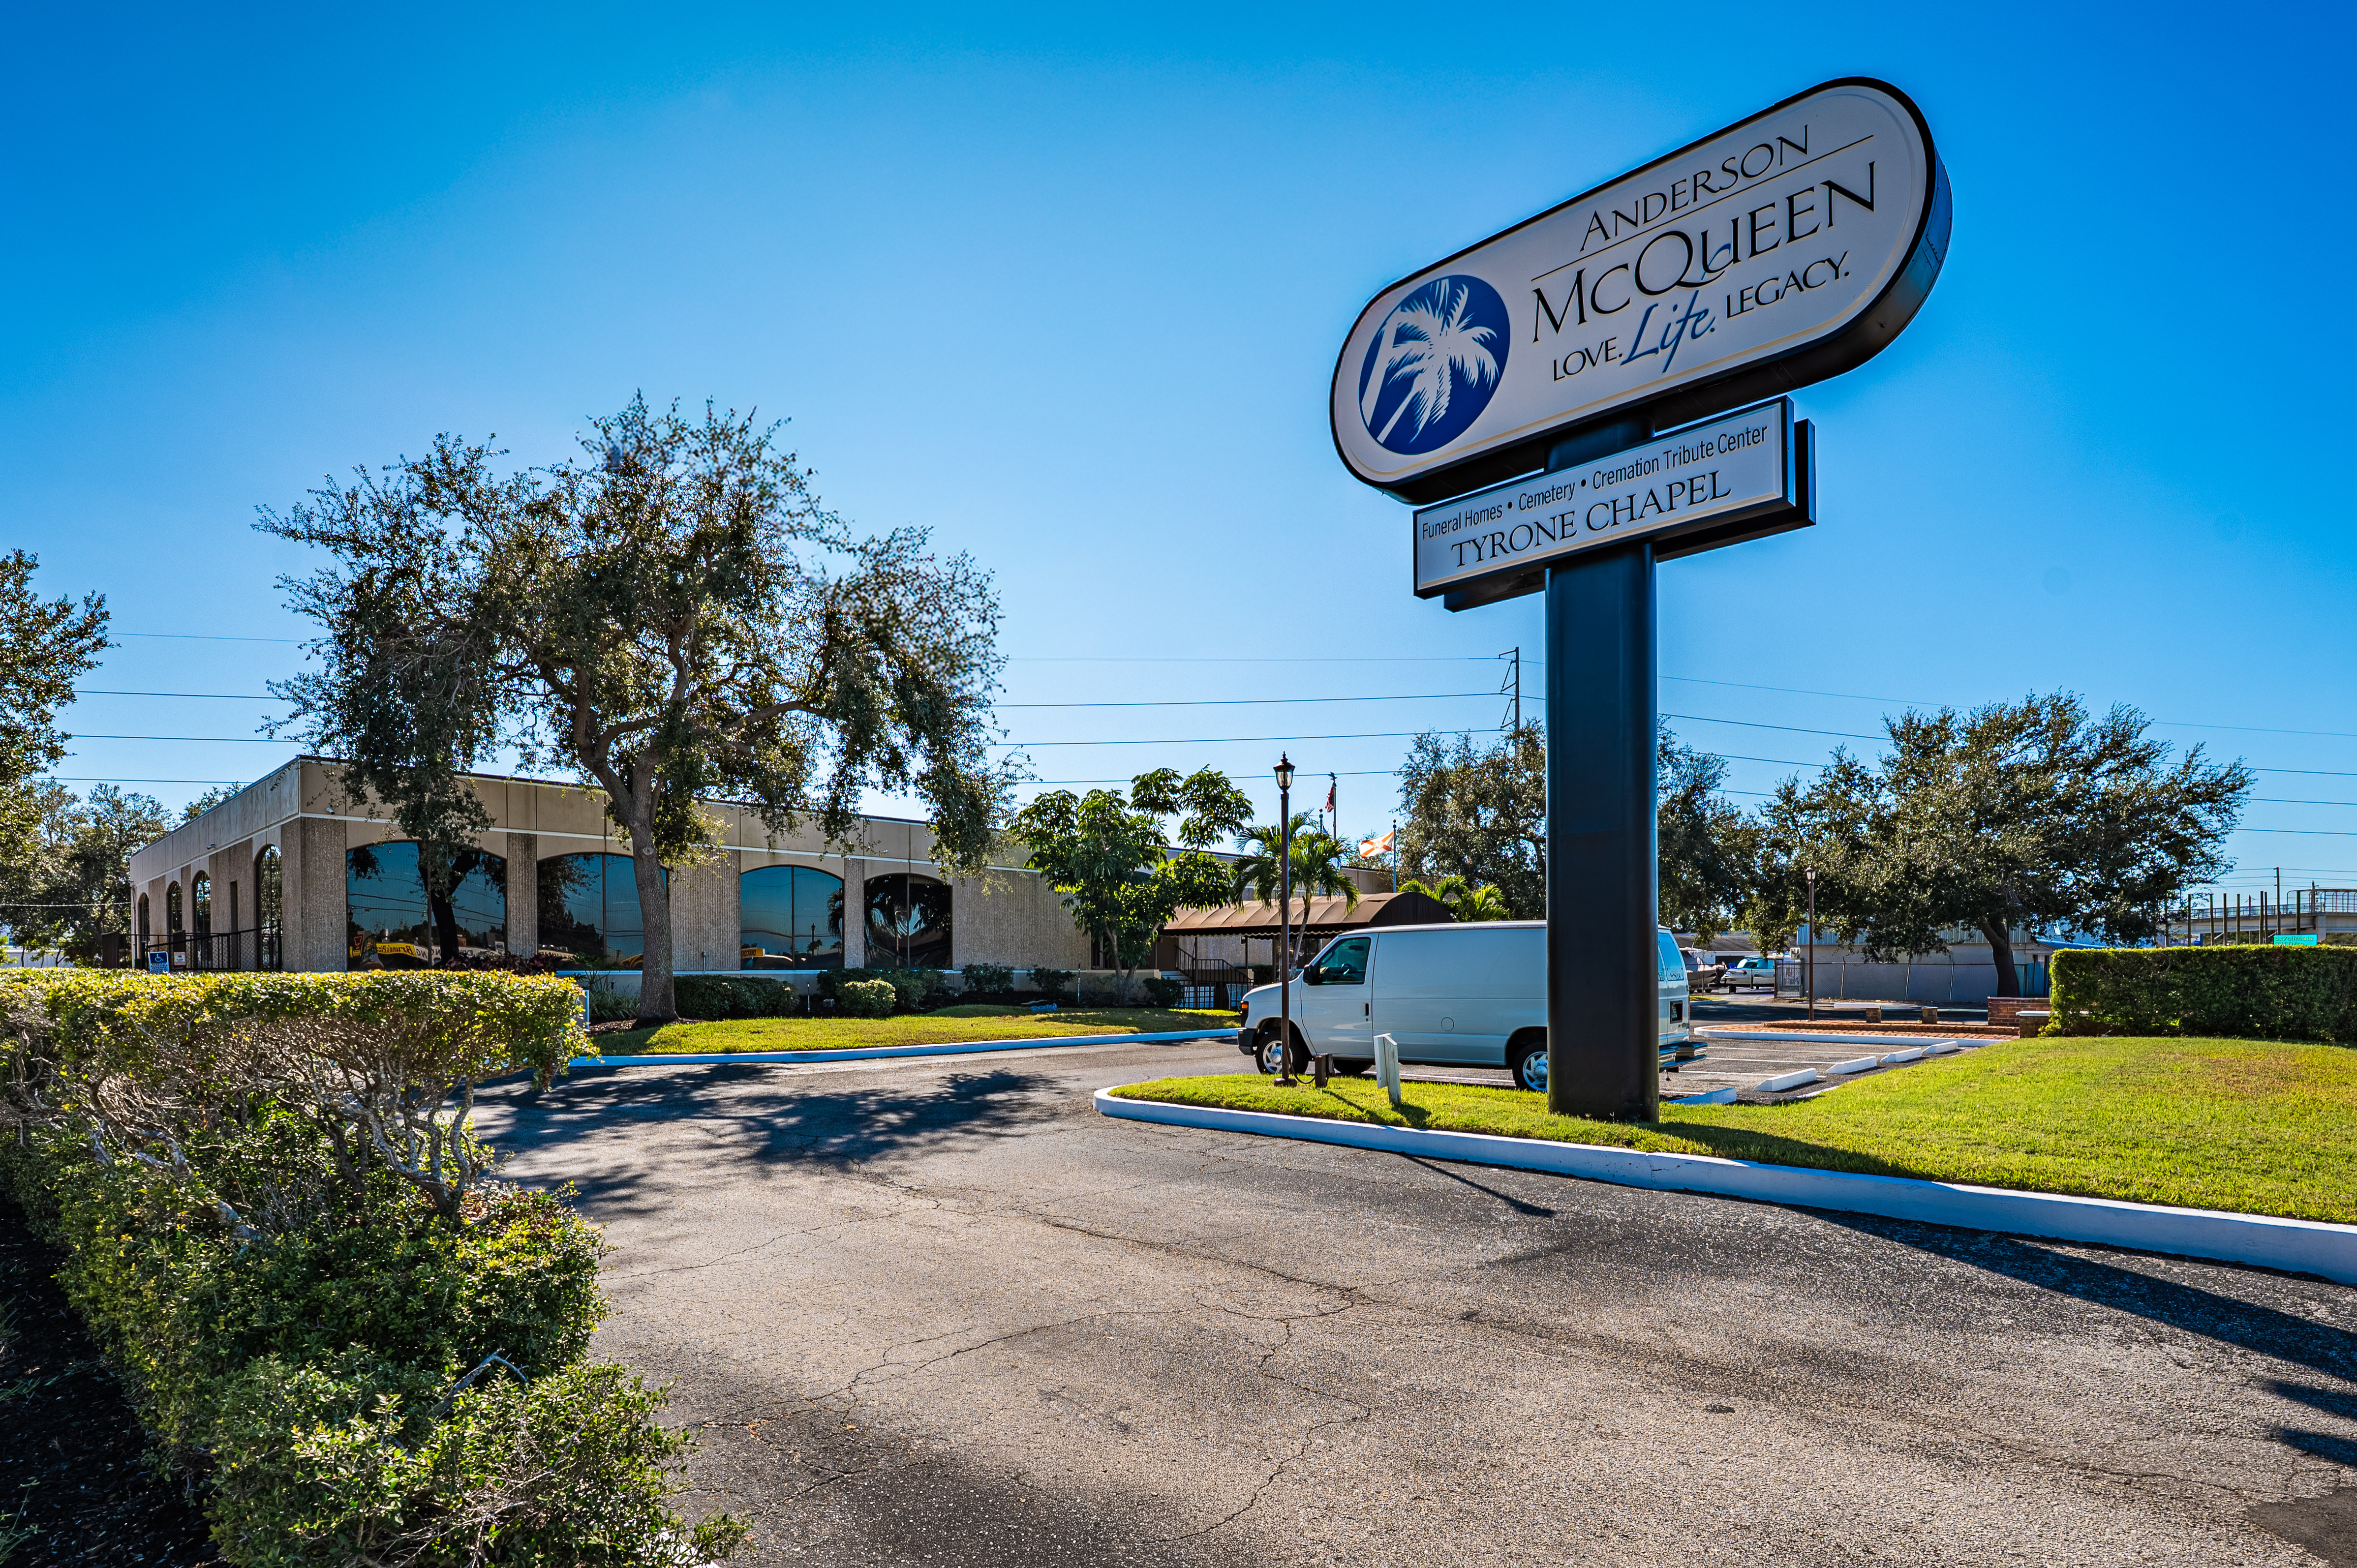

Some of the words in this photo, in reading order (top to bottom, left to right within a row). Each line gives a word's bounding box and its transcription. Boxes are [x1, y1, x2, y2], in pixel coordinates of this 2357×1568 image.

[1579, 124, 1808, 253] ANDERSON
[1553, 336, 1623, 382] LOVE.
[1620, 243, 1731, 374] Life.
[1726, 251, 1850, 319] LEGACY.
[1423, 512, 1461, 540] Funeral
[1465, 504, 1502, 528] Homes
[1518, 482, 1575, 512] Cemetery
[1592, 457, 1659, 490] Cremation
[1663, 440, 1714, 470] Tribute
[1717, 425, 1768, 454] Center
[1451, 510, 1578, 568] TYRONE
[1586, 470, 1731, 532] CHAPEL
